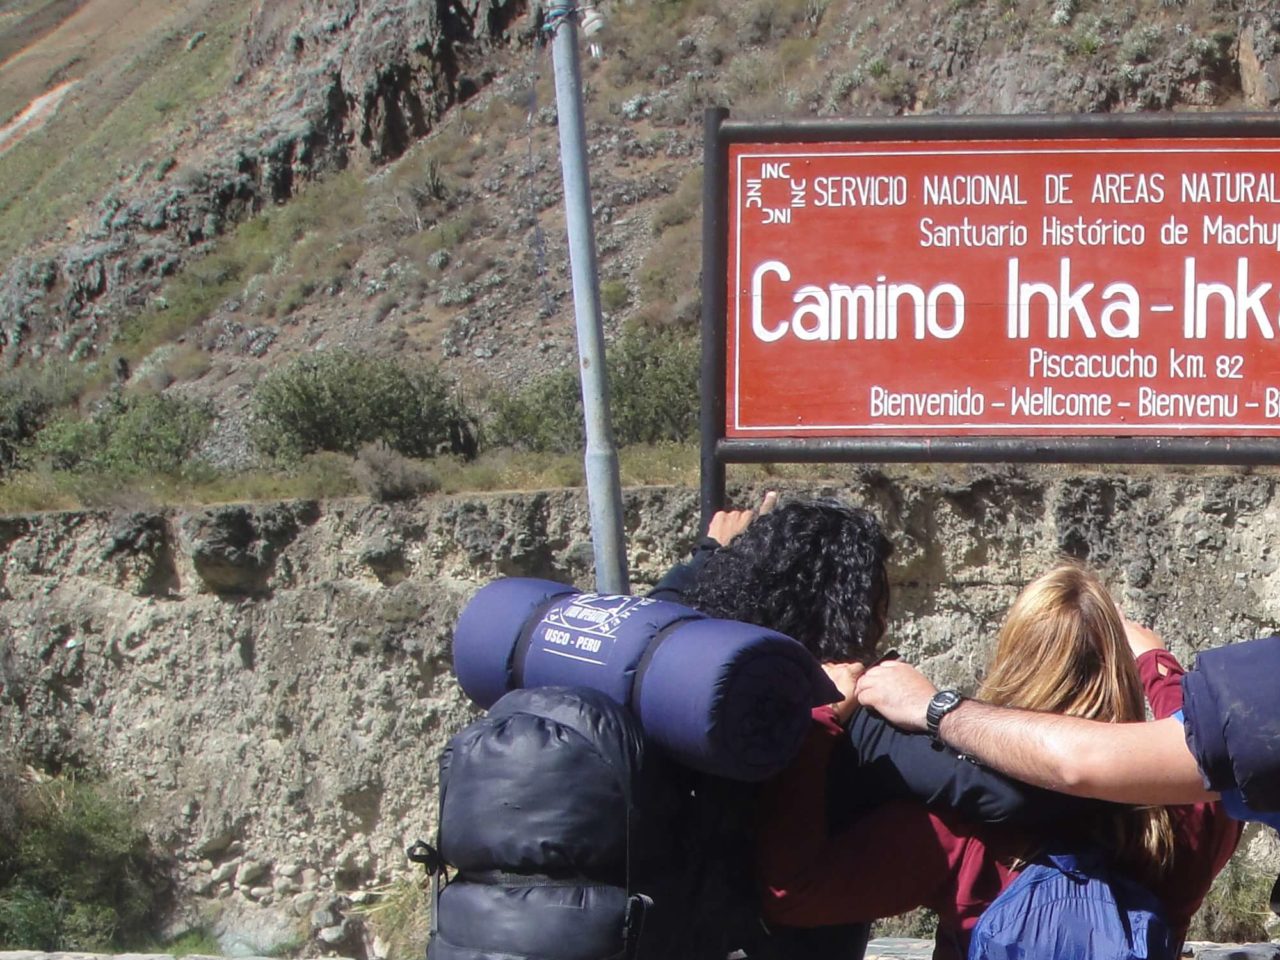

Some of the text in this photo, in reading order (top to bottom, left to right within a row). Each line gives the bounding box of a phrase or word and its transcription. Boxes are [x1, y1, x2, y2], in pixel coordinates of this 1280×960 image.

[762, 163, 790, 178] INC
[814, 176, 906, 206] SERVICIO
[924, 175, 1027, 205] NACIONAL
[1046, 175, 1073, 204] DE
[1092, 174, 1164, 203] AREAS
[920, 217, 1027, 246] Santuario
[1043, 216, 1144, 245] Histórico
[1161, 215, 1188, 244] de
[752, 260, 966, 342] Camino
[1030, 348, 1243, 378] Piscacucho km. 82
[871, 386, 984, 416] Bienvenido
[1011, 387, 1111, 416] Wellcome
[1138, 387, 1237, 417] Bienvenu
[575, 636, 601, 653] PERU
